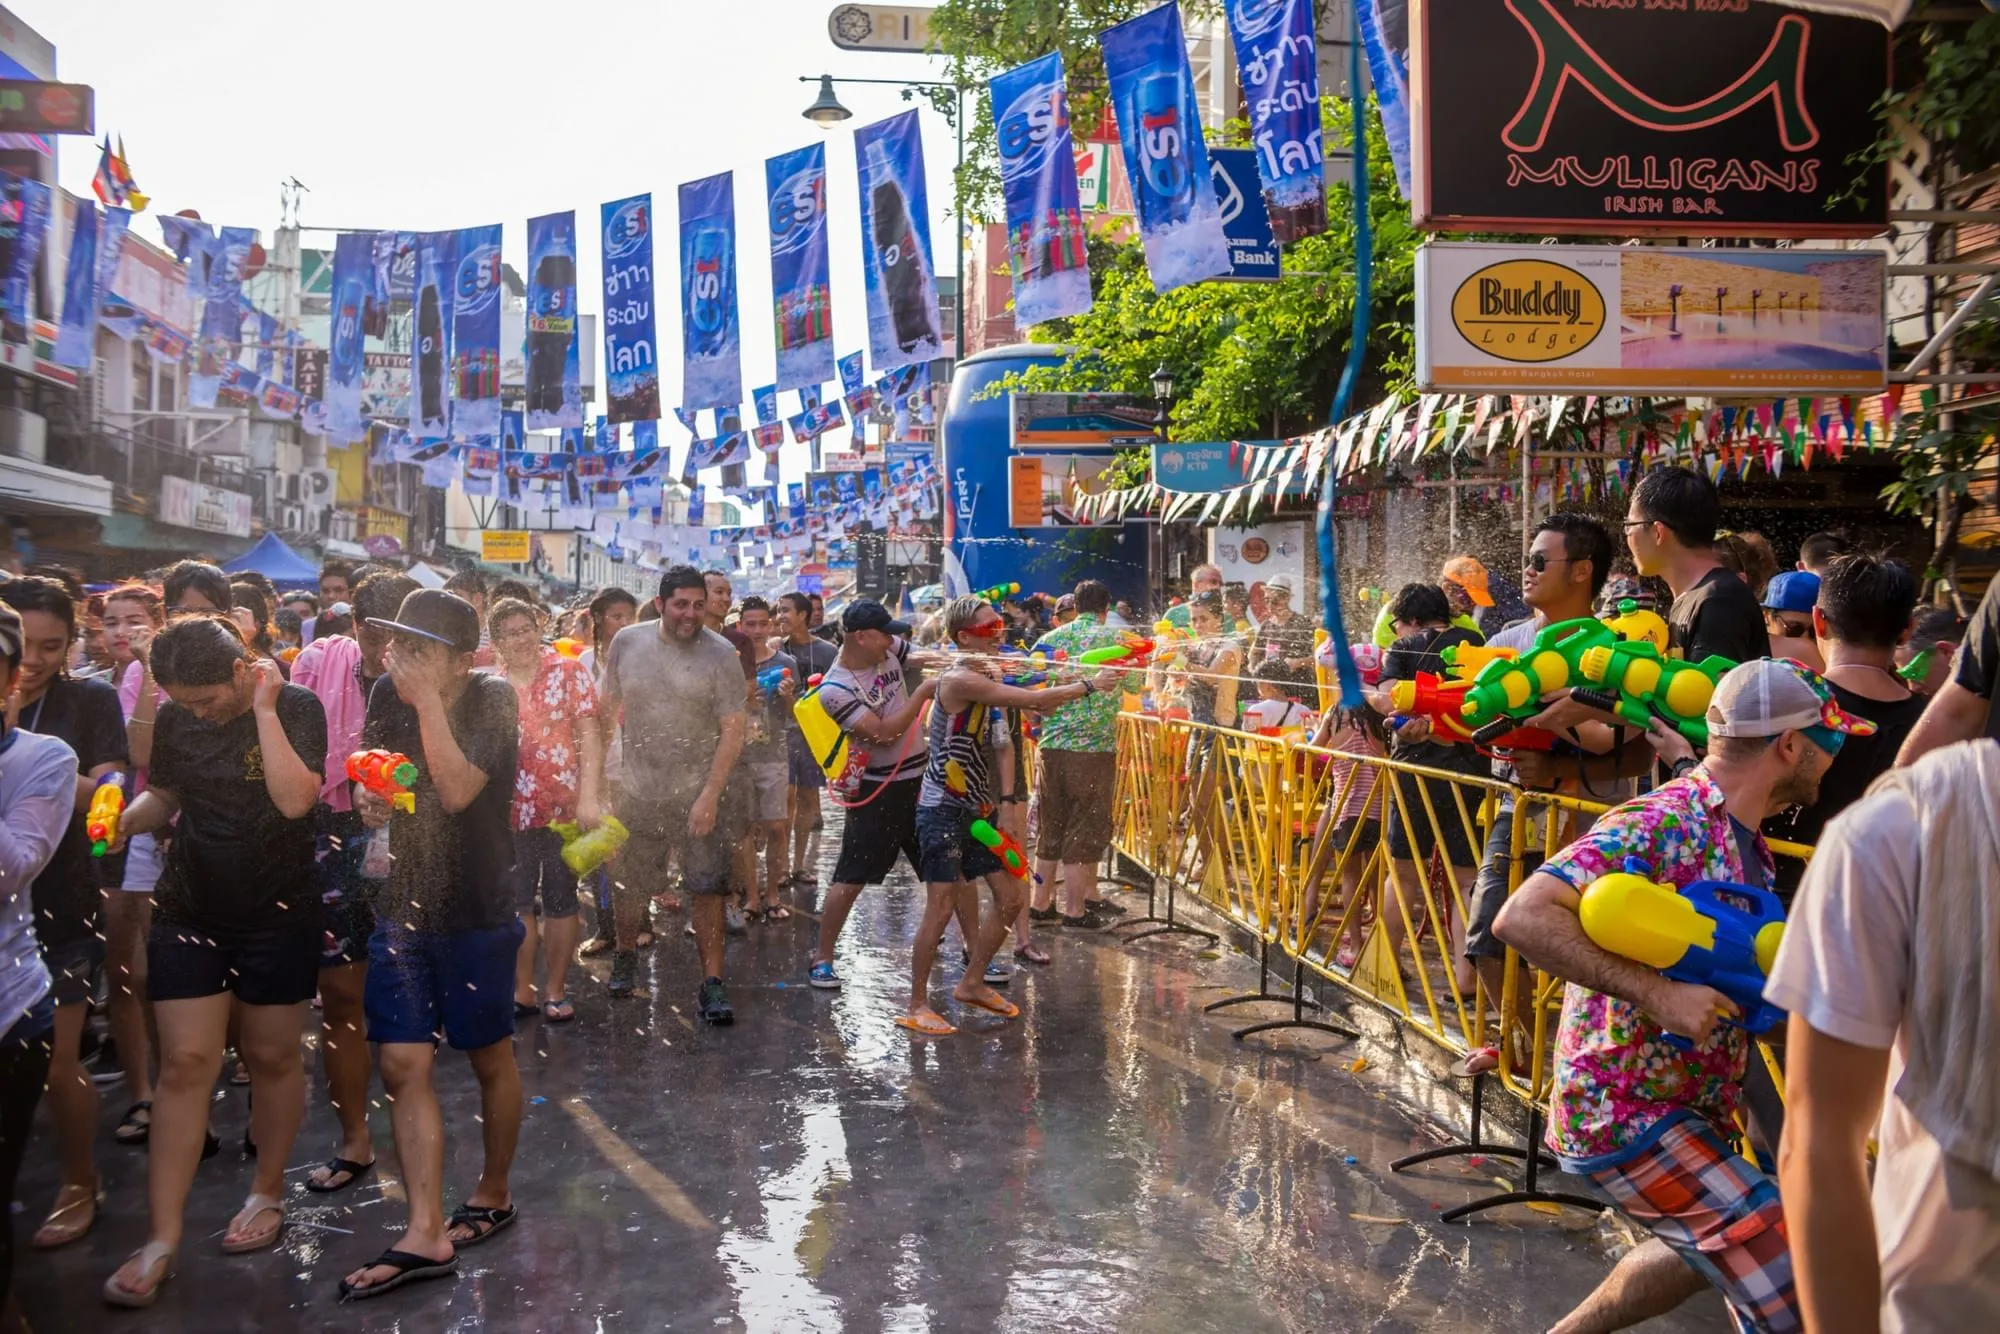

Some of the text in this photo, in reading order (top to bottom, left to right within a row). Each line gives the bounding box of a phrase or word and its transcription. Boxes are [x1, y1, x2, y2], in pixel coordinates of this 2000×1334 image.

[1506, 154, 1822, 193] MULLIGANS
[1603, 196, 1724, 215] IRISH BAR
[608, 207, 647, 245] est
[1233, 250, 1275, 265] Bank
[1479, 277, 1581, 325] Buddy
[607, 300, 649, 326] ระดับ
[1482, 328, 1577, 349] Lodge
[367, 355, 412, 368] TATTO
[606, 334, 653, 374] โลก
[1520, 370, 1563, 379] Bangkok
[1568, 370, 1595, 378] Hotel
[1187, 462, 1208, 471] KTB
